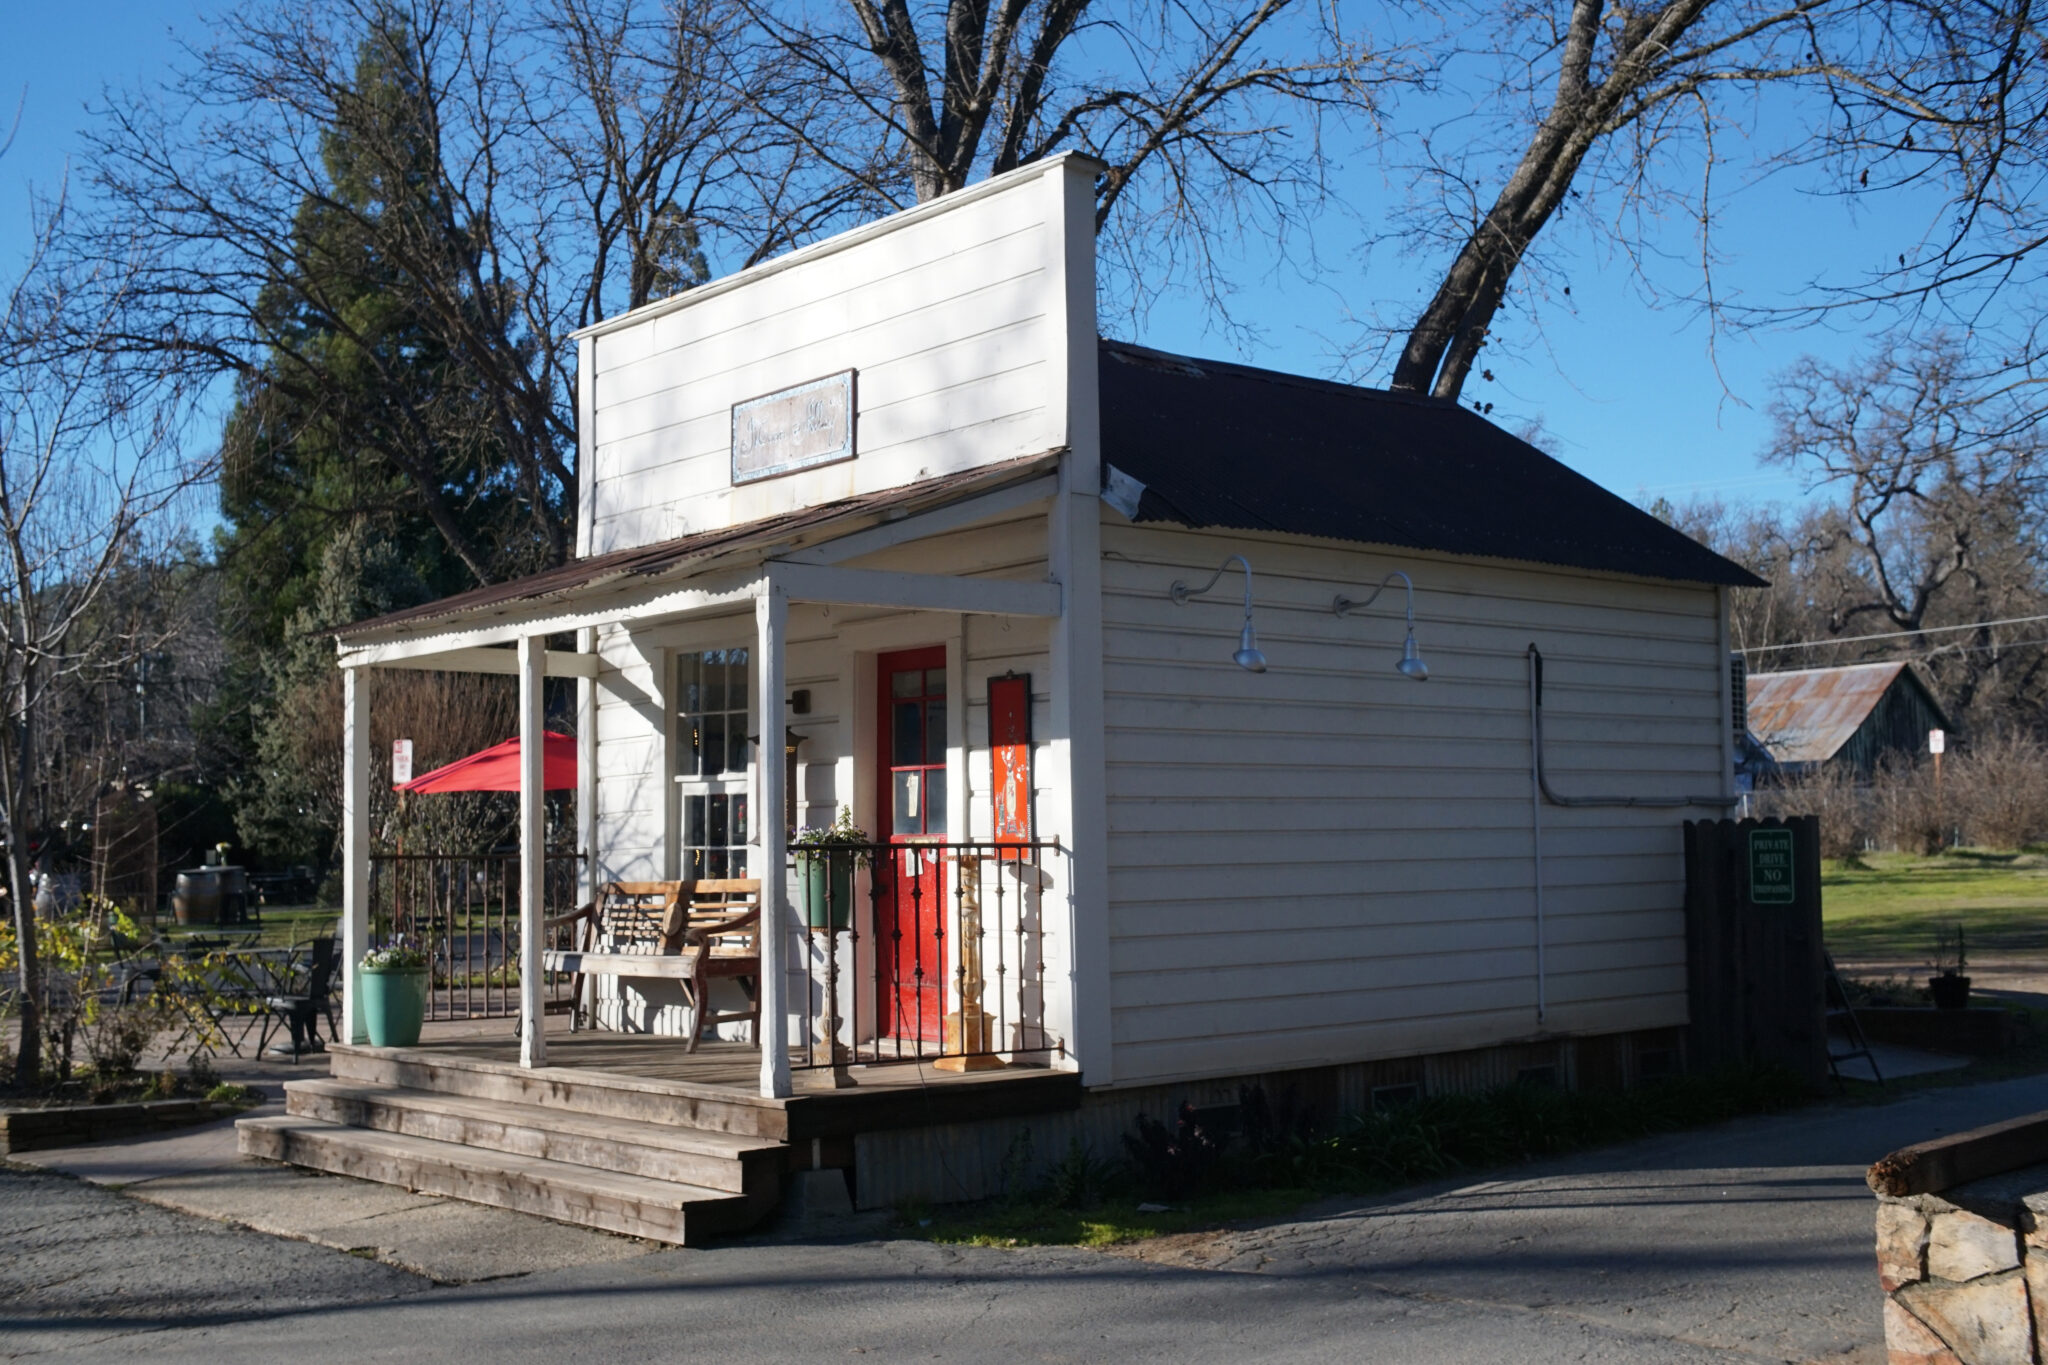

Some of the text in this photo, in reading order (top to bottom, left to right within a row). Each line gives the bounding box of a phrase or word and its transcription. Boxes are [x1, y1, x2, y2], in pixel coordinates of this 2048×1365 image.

[1754, 840, 1789, 850] PRIVATE
[1759, 853, 1785, 865] DRIVE
[1764, 869, 1782, 881] NO
